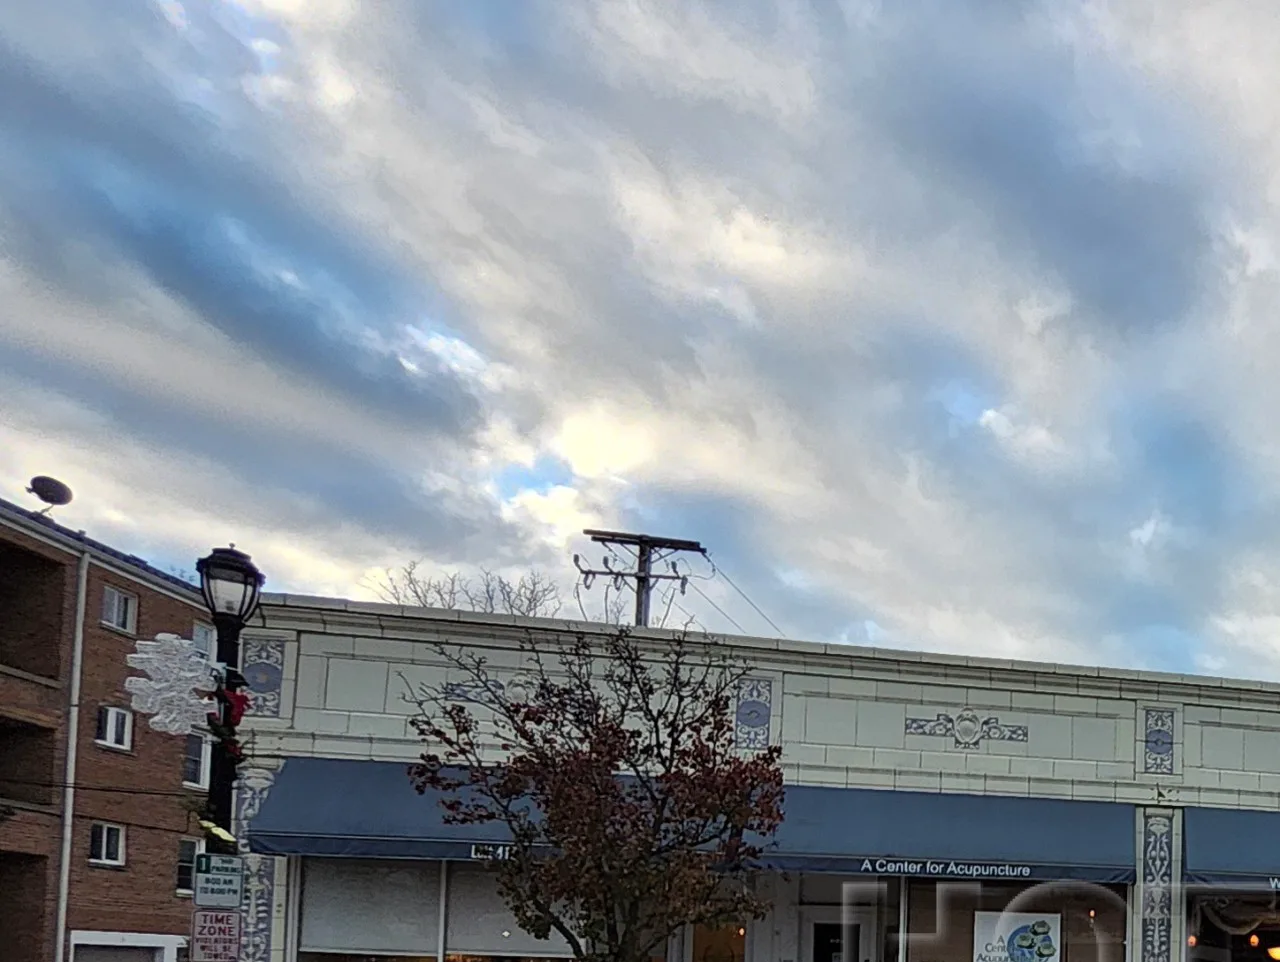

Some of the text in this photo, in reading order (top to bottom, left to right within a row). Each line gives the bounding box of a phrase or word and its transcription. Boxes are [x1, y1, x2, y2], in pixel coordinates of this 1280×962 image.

[860, 859, 1031, 877] A Center for Acupuncture
[202, 914, 234, 925] TIME
[198, 926, 236, 936] ZONE
